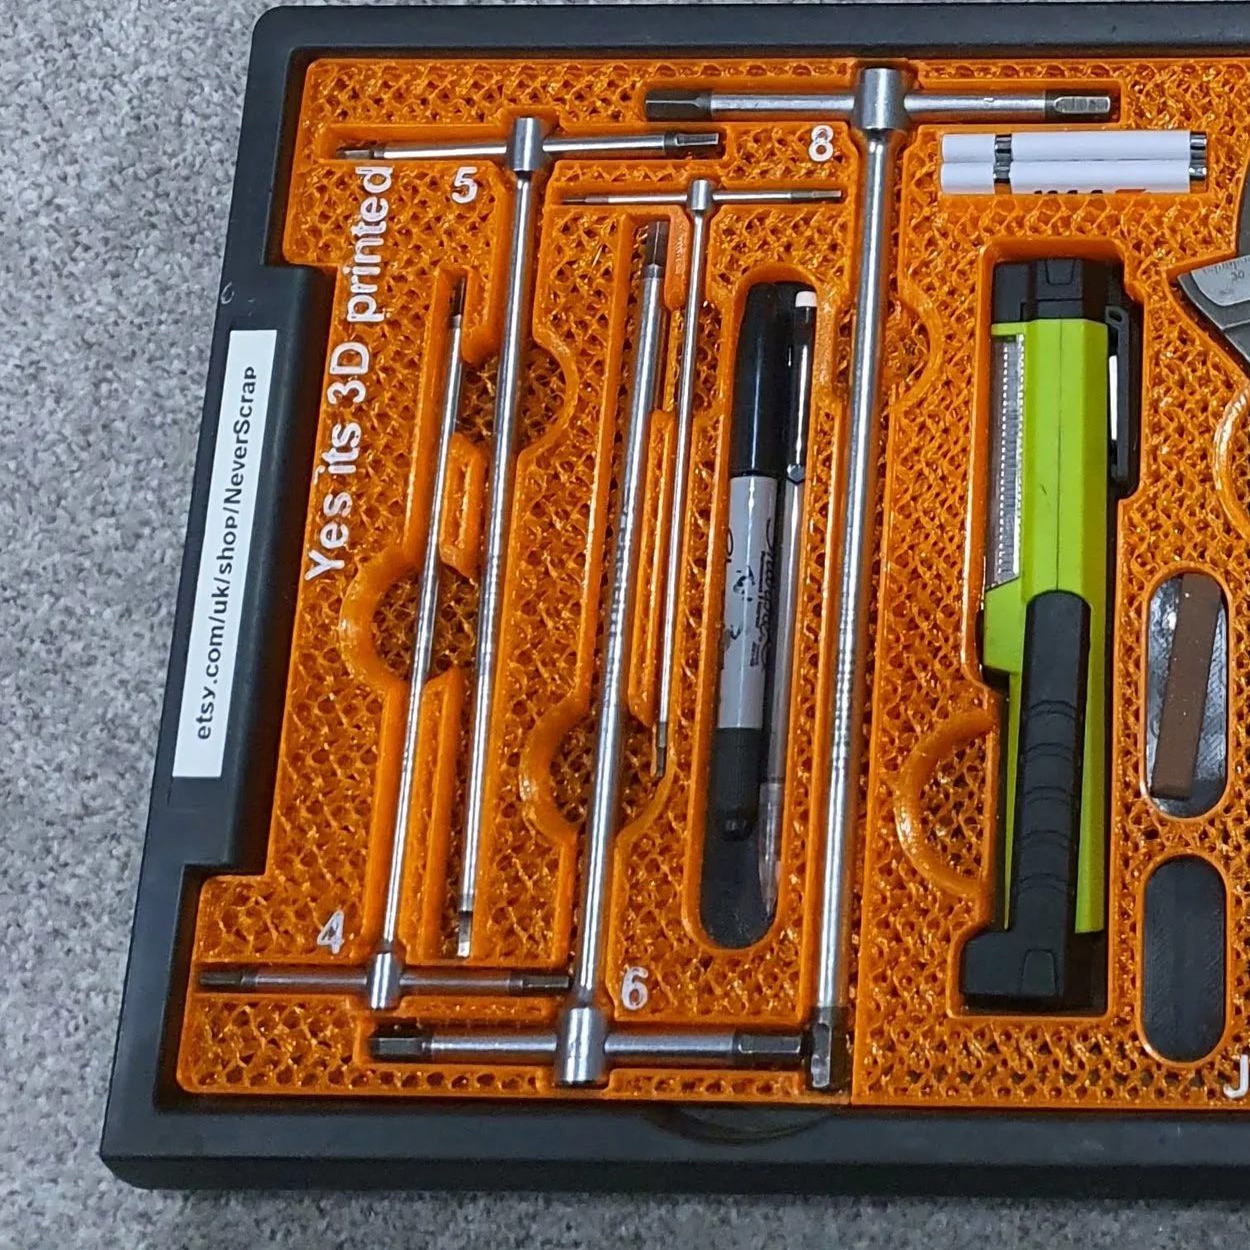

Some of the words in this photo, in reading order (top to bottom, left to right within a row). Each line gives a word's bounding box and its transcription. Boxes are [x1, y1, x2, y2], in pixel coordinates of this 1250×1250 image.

[808, 124, 835, 163] 8
[451, 166, 479, 205] 5
[347, 166, 394, 323] printed
[327, 340, 370, 406] 3D
[313, 421, 362, 478] its
[196, 365, 257, 740] etsy.com/uk/shop/NeverScrap
[304, 489, 355, 582] Yes
[316, 910, 345, 956] 4
[621, 966, 649, 1012] 6
